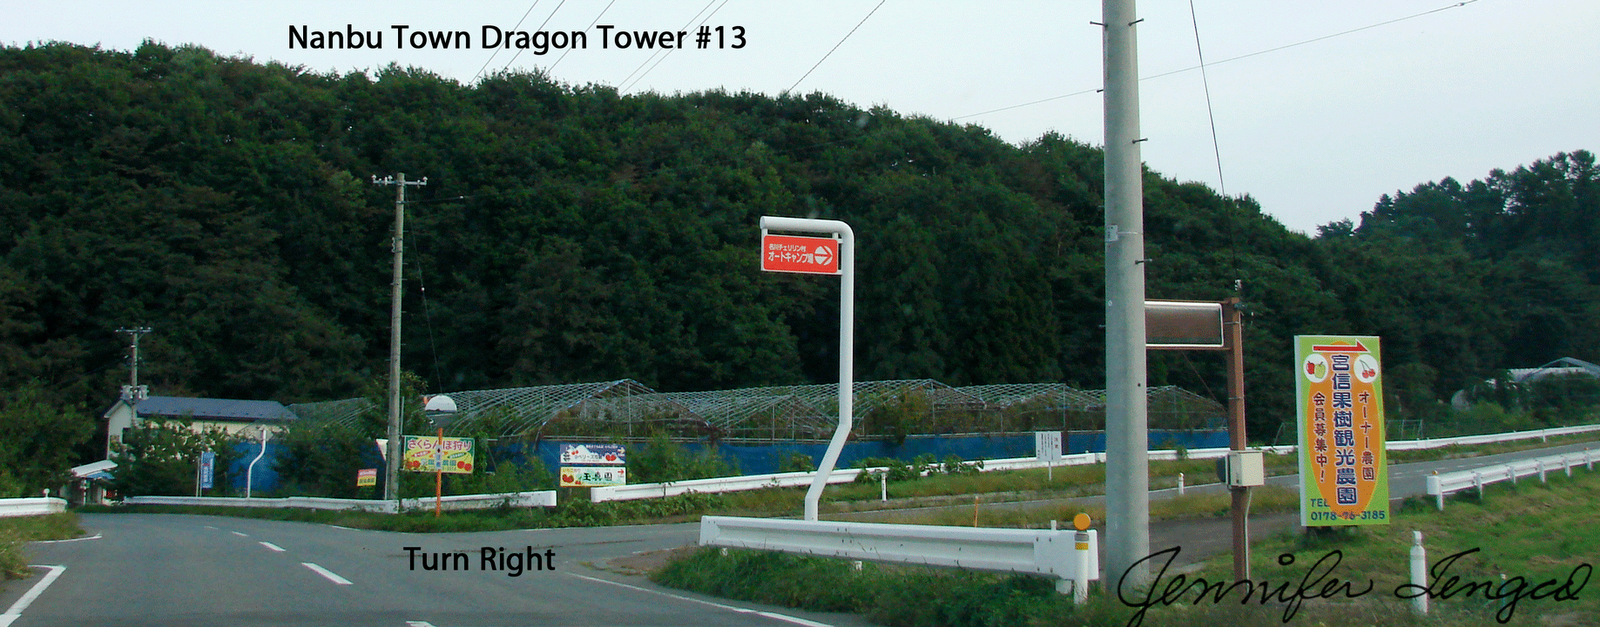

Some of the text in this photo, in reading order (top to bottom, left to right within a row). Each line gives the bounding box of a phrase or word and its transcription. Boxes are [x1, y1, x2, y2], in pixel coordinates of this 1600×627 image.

[1331, 354, 1358, 505] 宮信果樹観光農園
[1359, 391, 1375, 480] オーナー農園
[1310, 498, 1330, 508] TEL
[1310, 510, 1386, 521] 0178-76-3185
